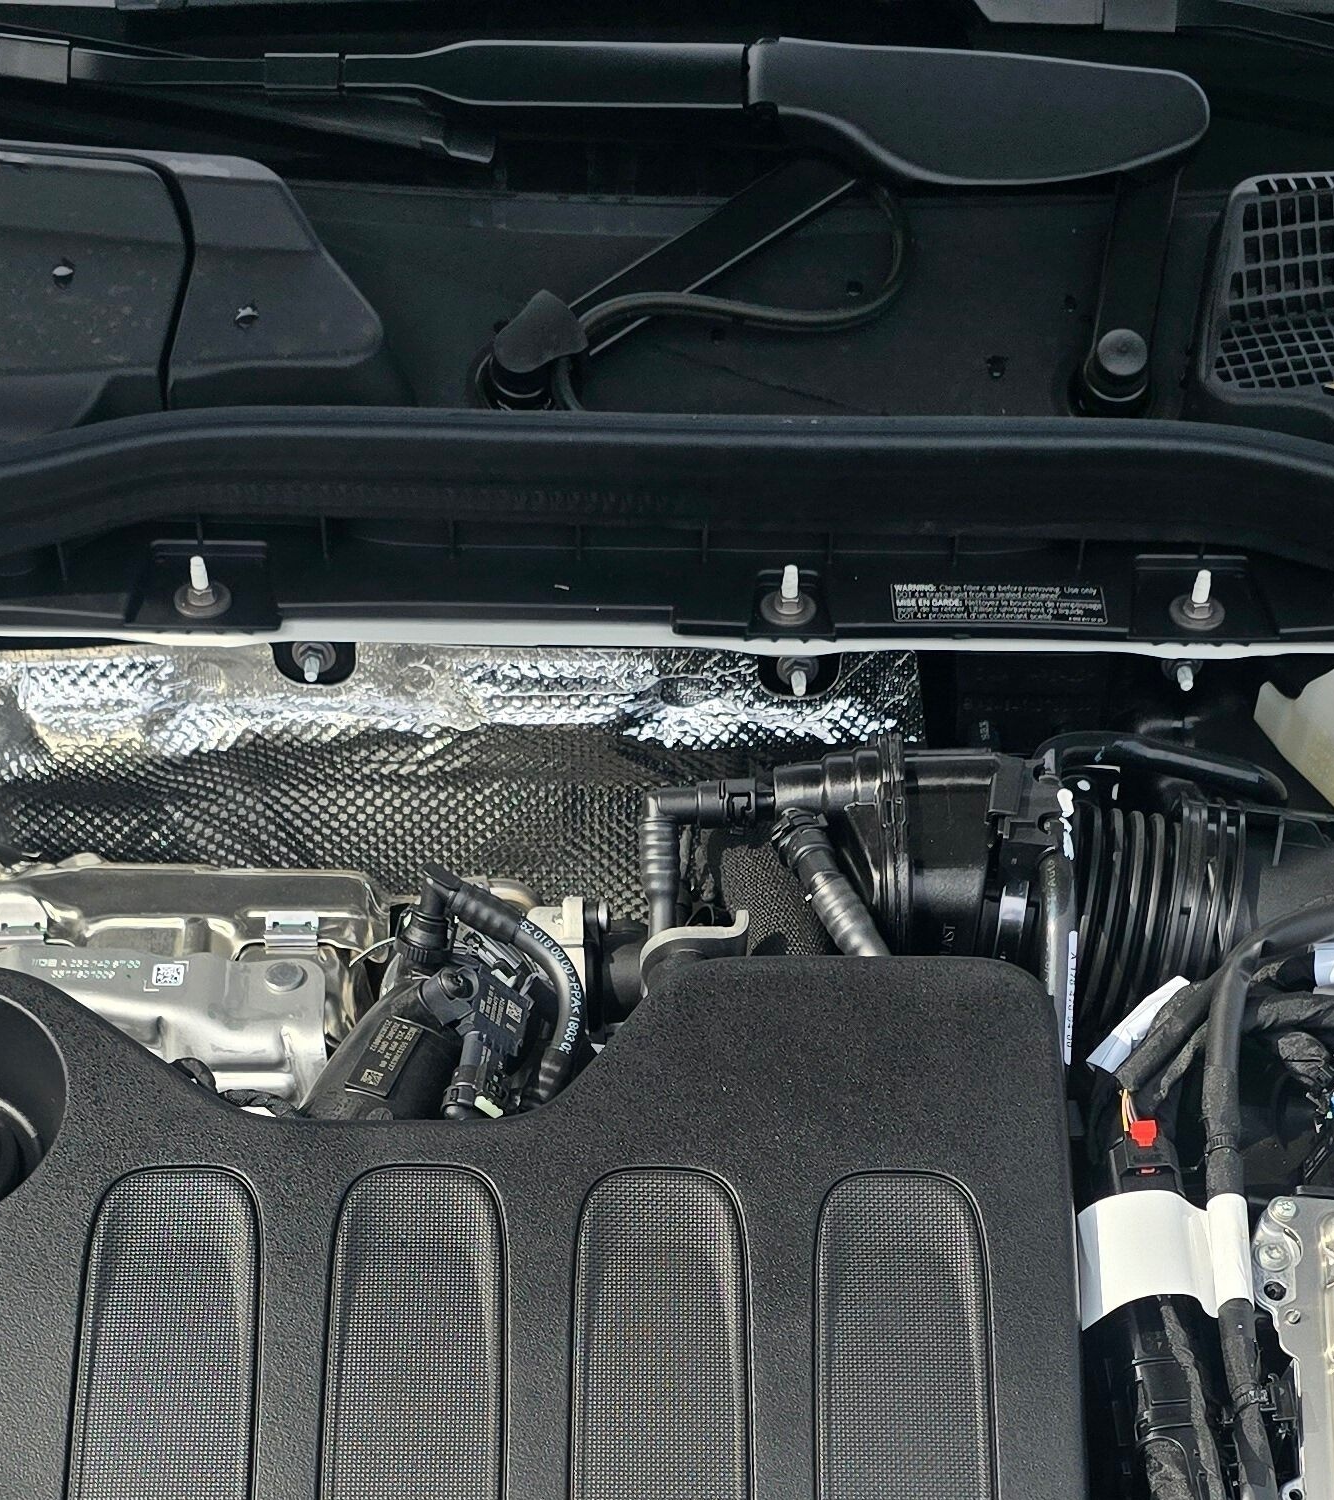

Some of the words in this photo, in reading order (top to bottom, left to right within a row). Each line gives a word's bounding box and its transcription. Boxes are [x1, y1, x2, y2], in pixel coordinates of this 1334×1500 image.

[894, 583, 936, 592] WARNING:
[998, 584, 1023, 592] before
[533, 929, 554, 948] 018
[550, 945, 565, 961] 00
[560, 959, 575, 975] 00
[569, 975, 582, 1015] >PPA<
